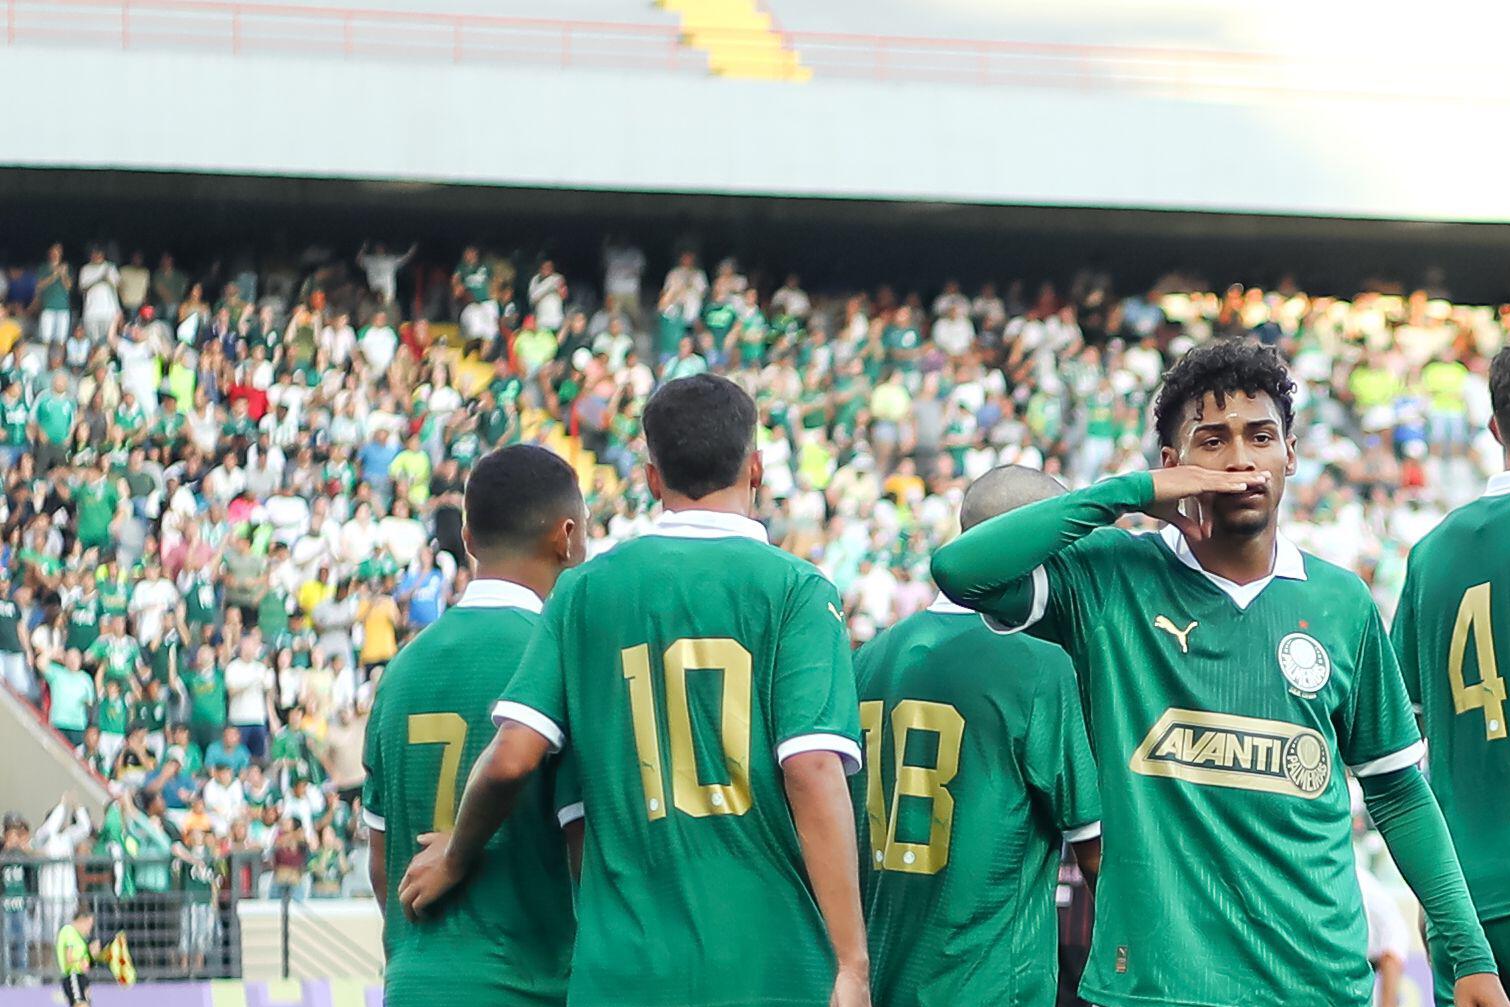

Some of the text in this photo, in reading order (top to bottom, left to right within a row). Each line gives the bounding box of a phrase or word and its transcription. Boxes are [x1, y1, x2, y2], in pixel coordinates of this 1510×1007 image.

[622, 638, 752, 821] 10
[1448, 582, 1507, 740] 4
[408, 713, 467, 833] 7
[859, 700, 967, 875] 18
[1156, 728, 1282, 773] AVANTI
[1287, 754, 1328, 792] PALMEIRAS
